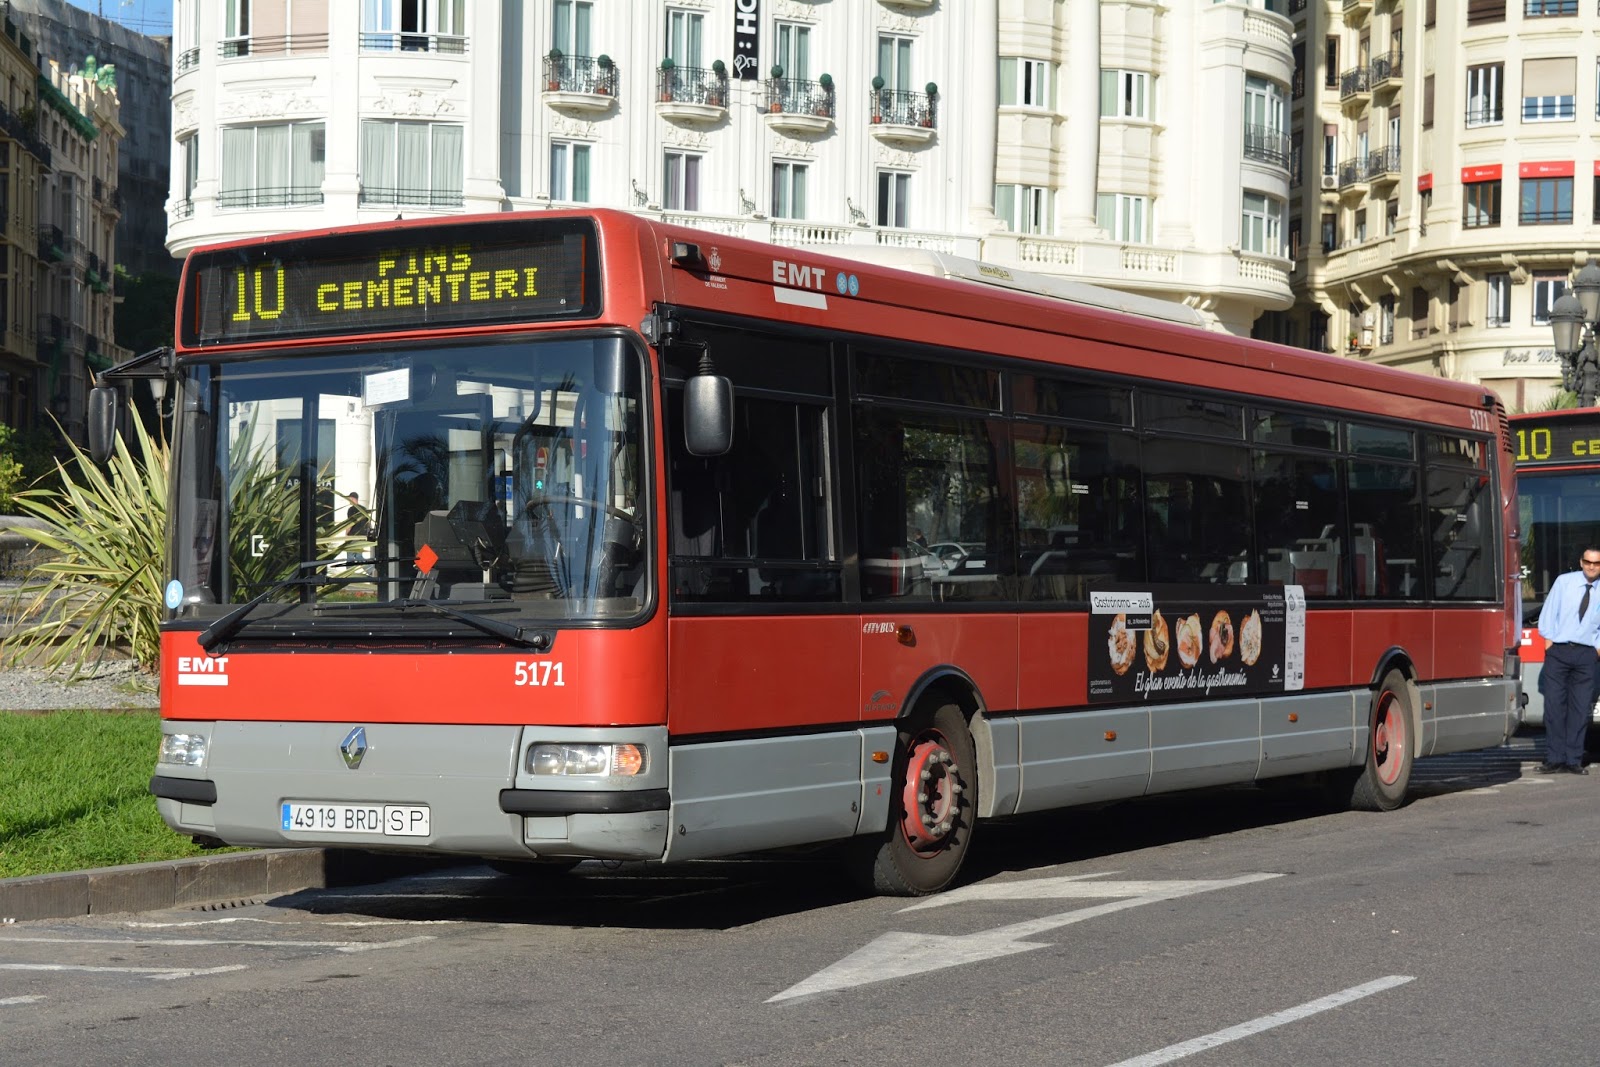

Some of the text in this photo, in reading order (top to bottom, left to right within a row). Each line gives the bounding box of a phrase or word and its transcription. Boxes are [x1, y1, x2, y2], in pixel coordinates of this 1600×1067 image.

[317, 267, 538, 312] CEMENTERI
[772, 260, 826, 289] EMT
[231, 262, 285, 322] 10
[1469, 409, 1489, 431] 5171
[1516, 429, 1551, 460] 10
[862, 622, 895, 634] CITYBUS
[178, 656, 565, 687] EMT 5171
[1134, 671, 1144, 692] El
[1144, 671, 1163, 699] gran
[1163, 669, 1187, 690] evento
[1187, 669, 1198, 688] de
[1197, 668, 1206, 688] la
[295, 807, 336, 828] 4919
[345, 809, 378, 830] BRD
[390, 810, 424, 832] SP
